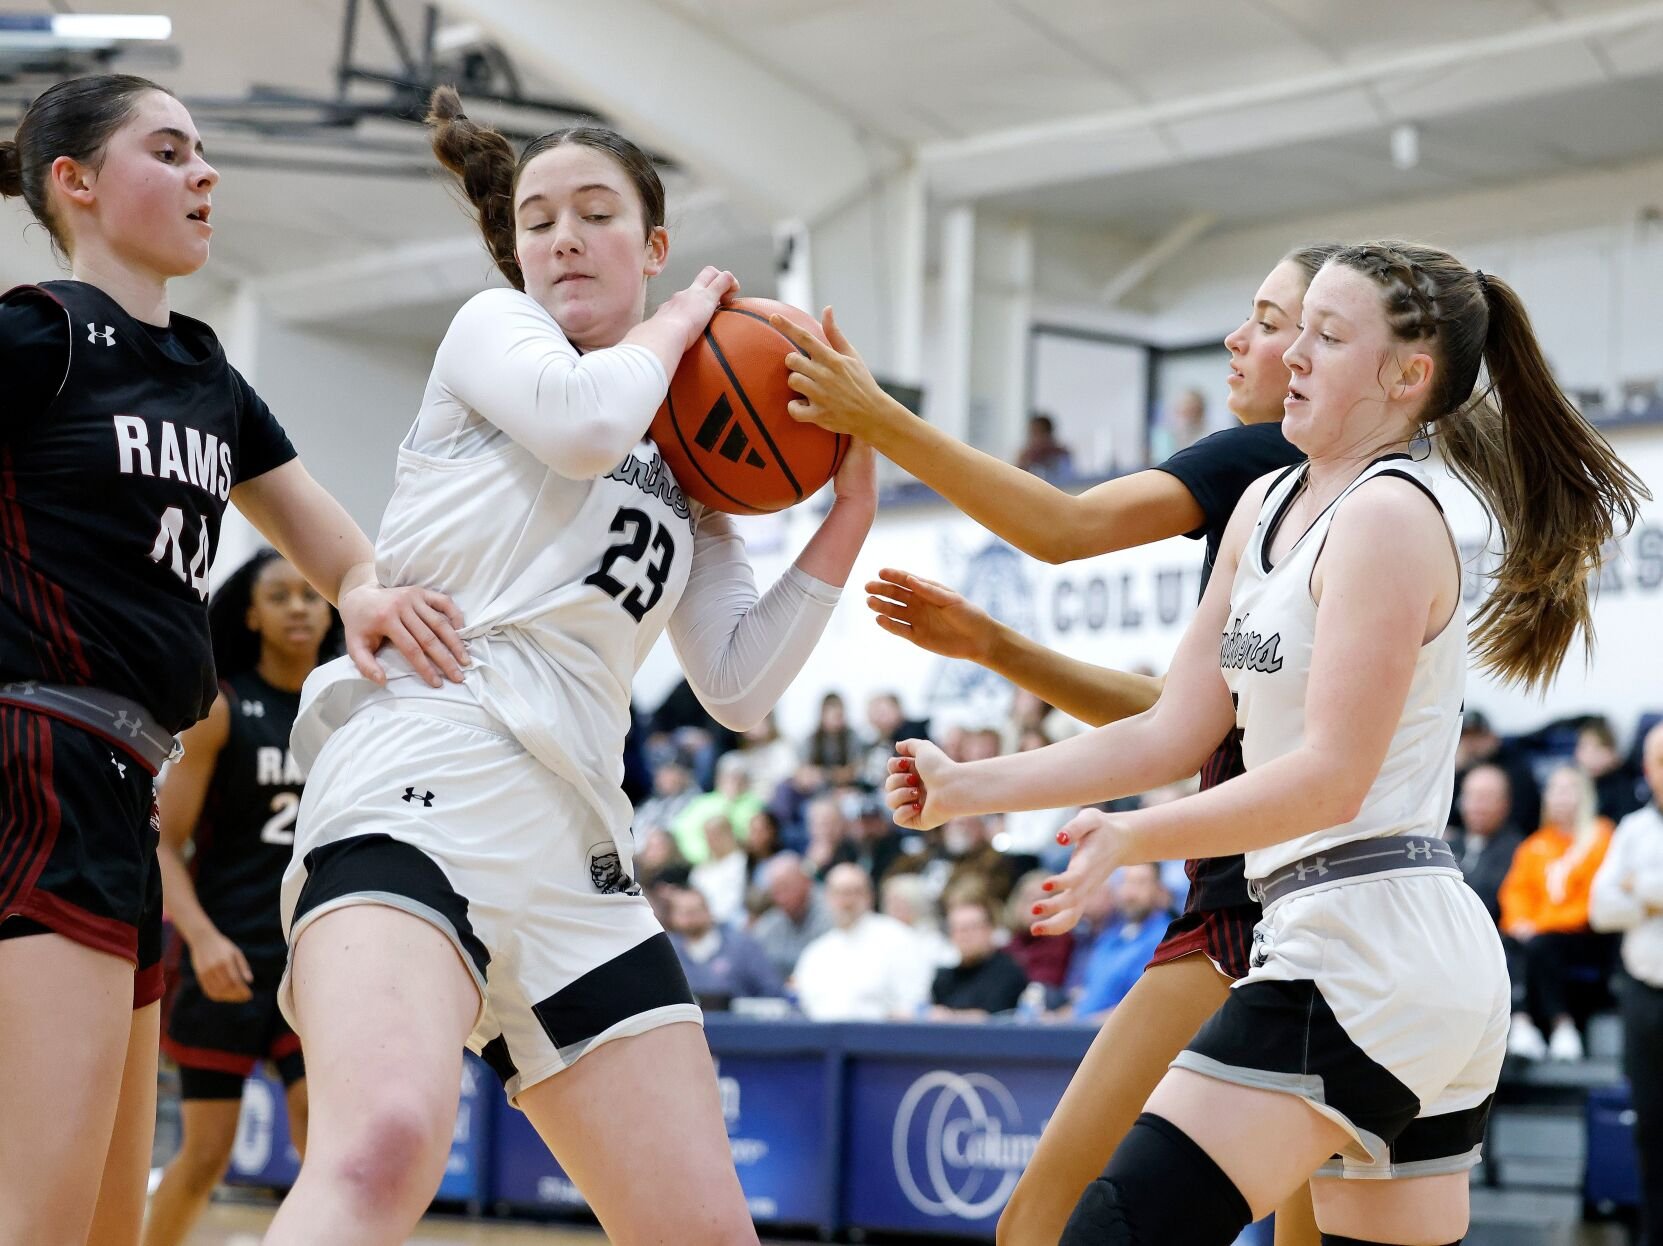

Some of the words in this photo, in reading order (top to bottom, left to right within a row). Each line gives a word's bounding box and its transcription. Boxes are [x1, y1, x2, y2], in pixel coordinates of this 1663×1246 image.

[113, 415, 233, 502] RAMS
[582, 506, 675, 624] 23
[1052, 567, 1198, 635] COLU
[256, 746, 307, 786] RA
[942, 1116, 1048, 1170] Colum
